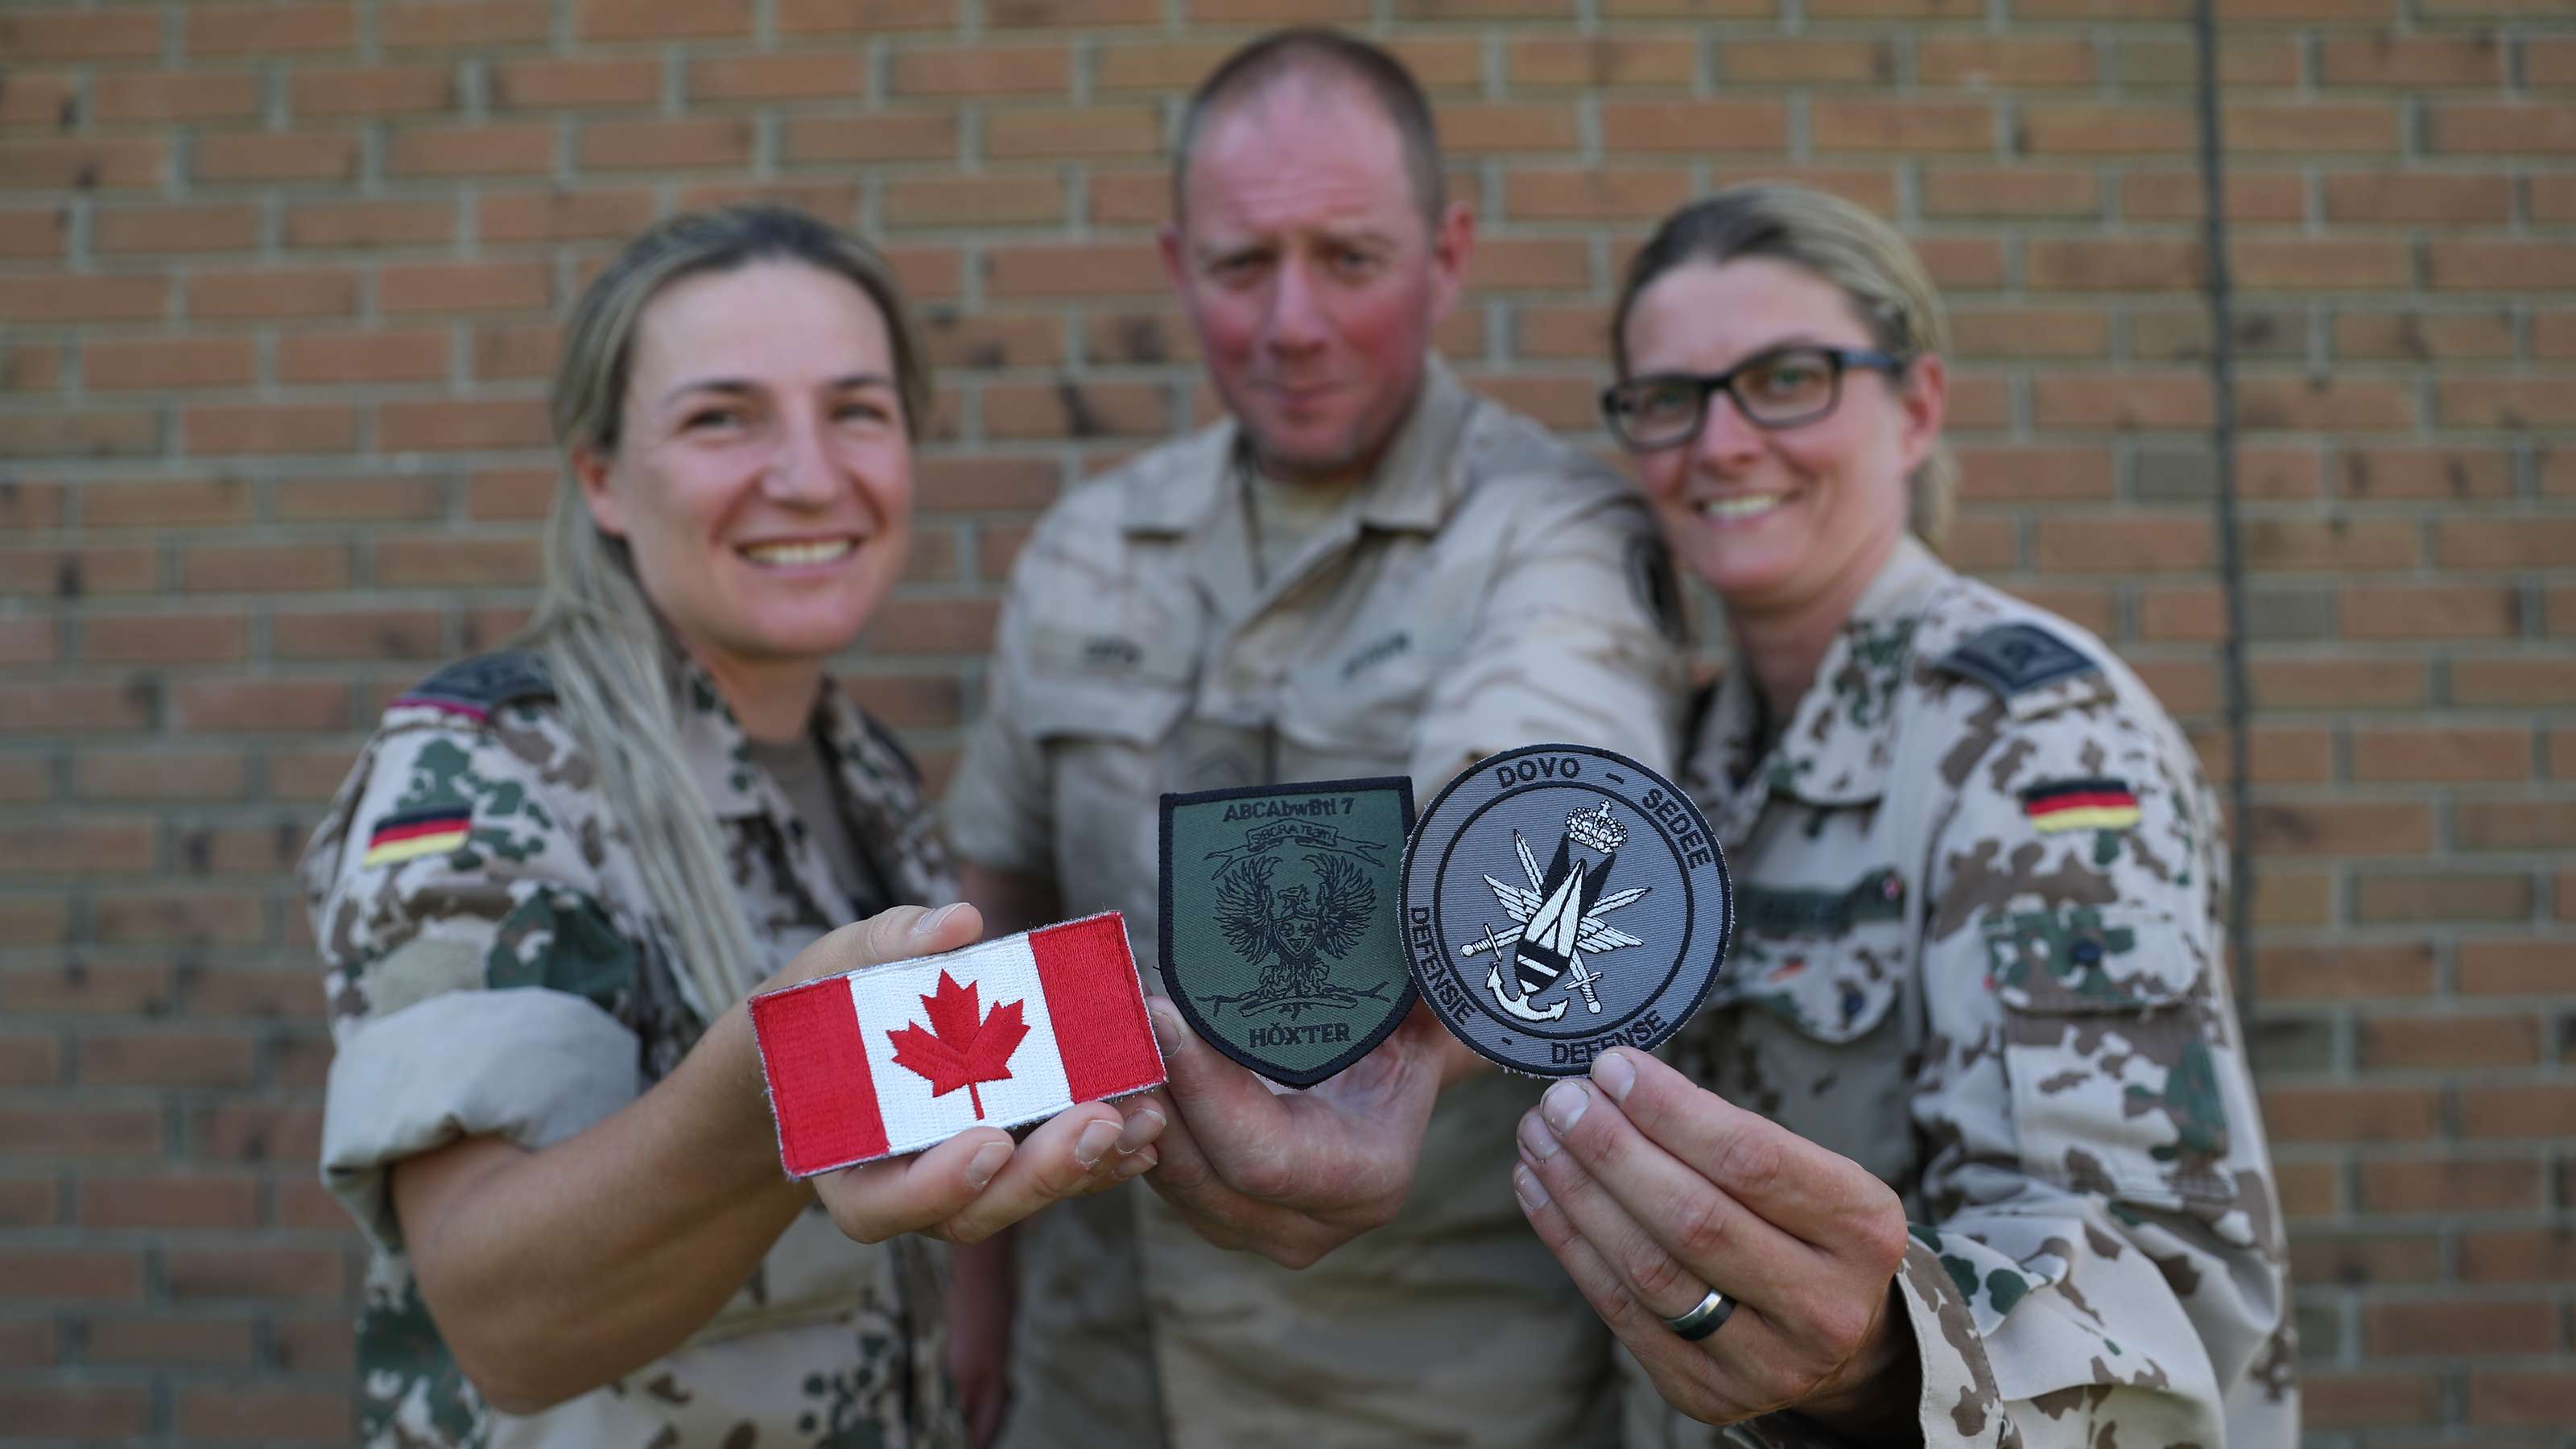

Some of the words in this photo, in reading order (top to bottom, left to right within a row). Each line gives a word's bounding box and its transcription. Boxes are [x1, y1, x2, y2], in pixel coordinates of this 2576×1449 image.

[1223, 798, 1337, 822] ABCAbwBtl
[1340, 797, 1355, 815] 7
[1496, 757, 1580, 789] DOVO
[1642, 788, 1712, 869] SEDEE
[1410, 906, 1476, 1026] DEFENSIE
[1249, 1022, 1351, 1047] HÖXTER
